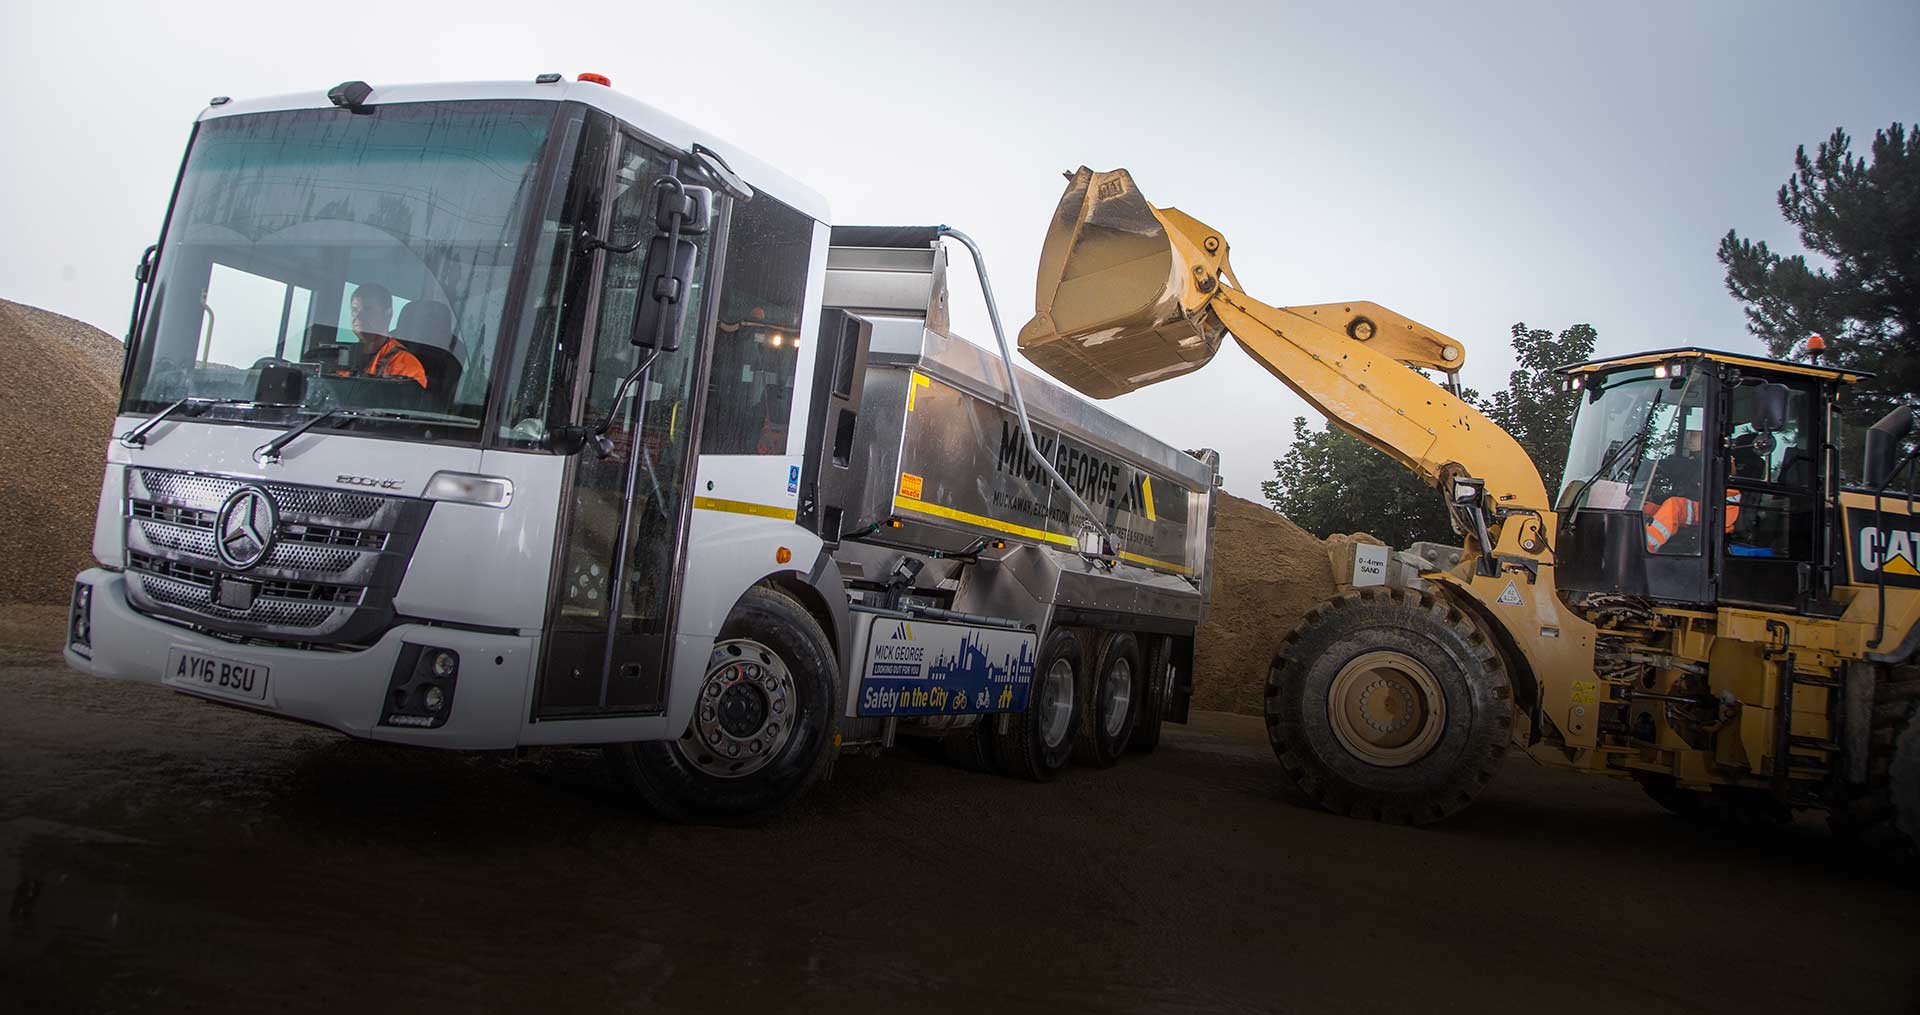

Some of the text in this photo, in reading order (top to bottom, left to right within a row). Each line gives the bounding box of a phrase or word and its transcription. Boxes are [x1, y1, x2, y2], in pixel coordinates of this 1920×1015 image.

[997, 421, 1120, 508] MICK GEORGE
[1360, 566, 1380, 575] SAND
[874, 645, 924, 661] MICK GEORGE
[177, 655, 256, 692] AY16 BSU
[874, 664, 919, 675] LOOKING OUT FOR YOU
[864, 686, 949, 713] Safety in the City
